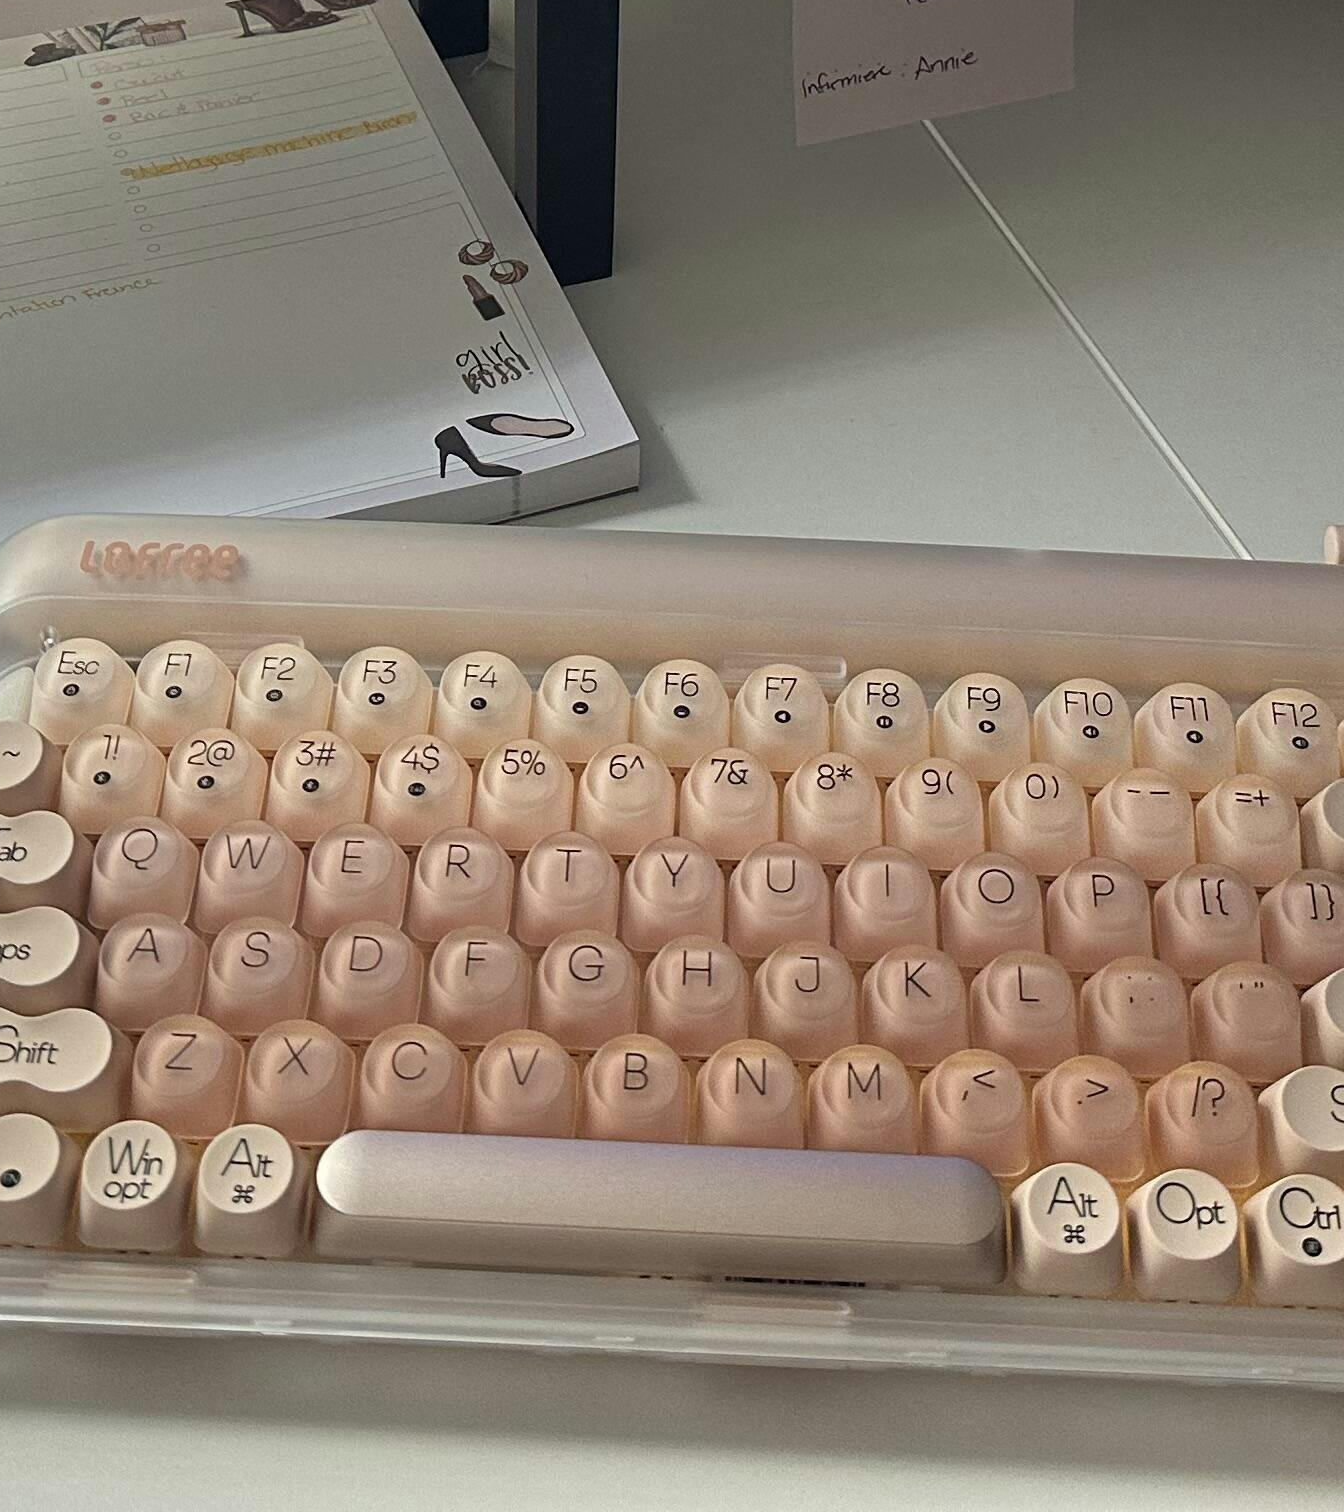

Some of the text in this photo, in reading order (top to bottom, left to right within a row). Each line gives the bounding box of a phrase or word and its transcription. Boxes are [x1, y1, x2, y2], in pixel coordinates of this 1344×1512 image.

[914, 48, 979, 80] Annie
[80, 277, 163, 301] France
[455, 329, 520, 372] girl
[58, 652, 100, 678] Esc
[164, 653, 193, 679] F1
[259, 656, 296, 682] F2
[362, 660, 397, 685] F3
[463, 664, 498, 690] F4
[563, 668, 599, 694] F5
[663, 672, 700, 698] F6
[764, 676, 798, 702] F7
[865, 681, 901, 708] F8
[965, 686, 1002, 713] F9
[1062, 691, 1114, 718] F10
[1169, 695, 1210, 723] F11
[1270, 701, 1321, 730] F12
[187, 739, 235, 768] 2@
[295, 740, 337, 768] 3#
[400, 743, 441, 772] 4$
[500, 749, 547, 777] 5%
[709, 757, 750, 786] 7&
[920, 769, 954, 796] 9(
[1024, 773, 1061, 801] 0)
[1234, 788, 1271, 809] =+
[120, 828, 159, 871] Q
[224, 833, 272, 871] W
[340, 839, 366, 875] E
[444, 843, 472, 880] R
[555, 848, 582, 884] T
[660, 853, 690, 888] Y
[765, 857, 797, 894] U
[977, 867, 1016, 905] O
[1091, 874, 1116, 908] P
[126, 927, 161, 965] A
[240, 930, 272, 970] S
[349, 934, 384, 973] D
[463, 940, 489, 978] F
[567, 943, 605, 983] G
[681, 949, 713, 988] H
[794, 954, 822, 995] J
[903, 960, 934, 999] K
[1017, 965, 1041, 1004] L
[163, 1030, 199, 1073] Z
[277, 1036, 314, 1077] X
[391, 1040, 428, 1082] C
[506, 1045, 541, 1088] V
[622, 1051, 650, 1092] B
[733, 1055, 768, 1097] N
[846, 1060, 883, 1102] M
[1190, 1075, 1227, 1118] /?
[106, 1135, 163, 1180] Win
[220, 1136, 275, 1180] Alt
[102, 1178, 153, 1204] opt
[1046, 1175, 1100, 1219] Alt
[1155, 1179, 1227, 1230] Opt
[1278, 1185, 1343, 1232] Ctrl
